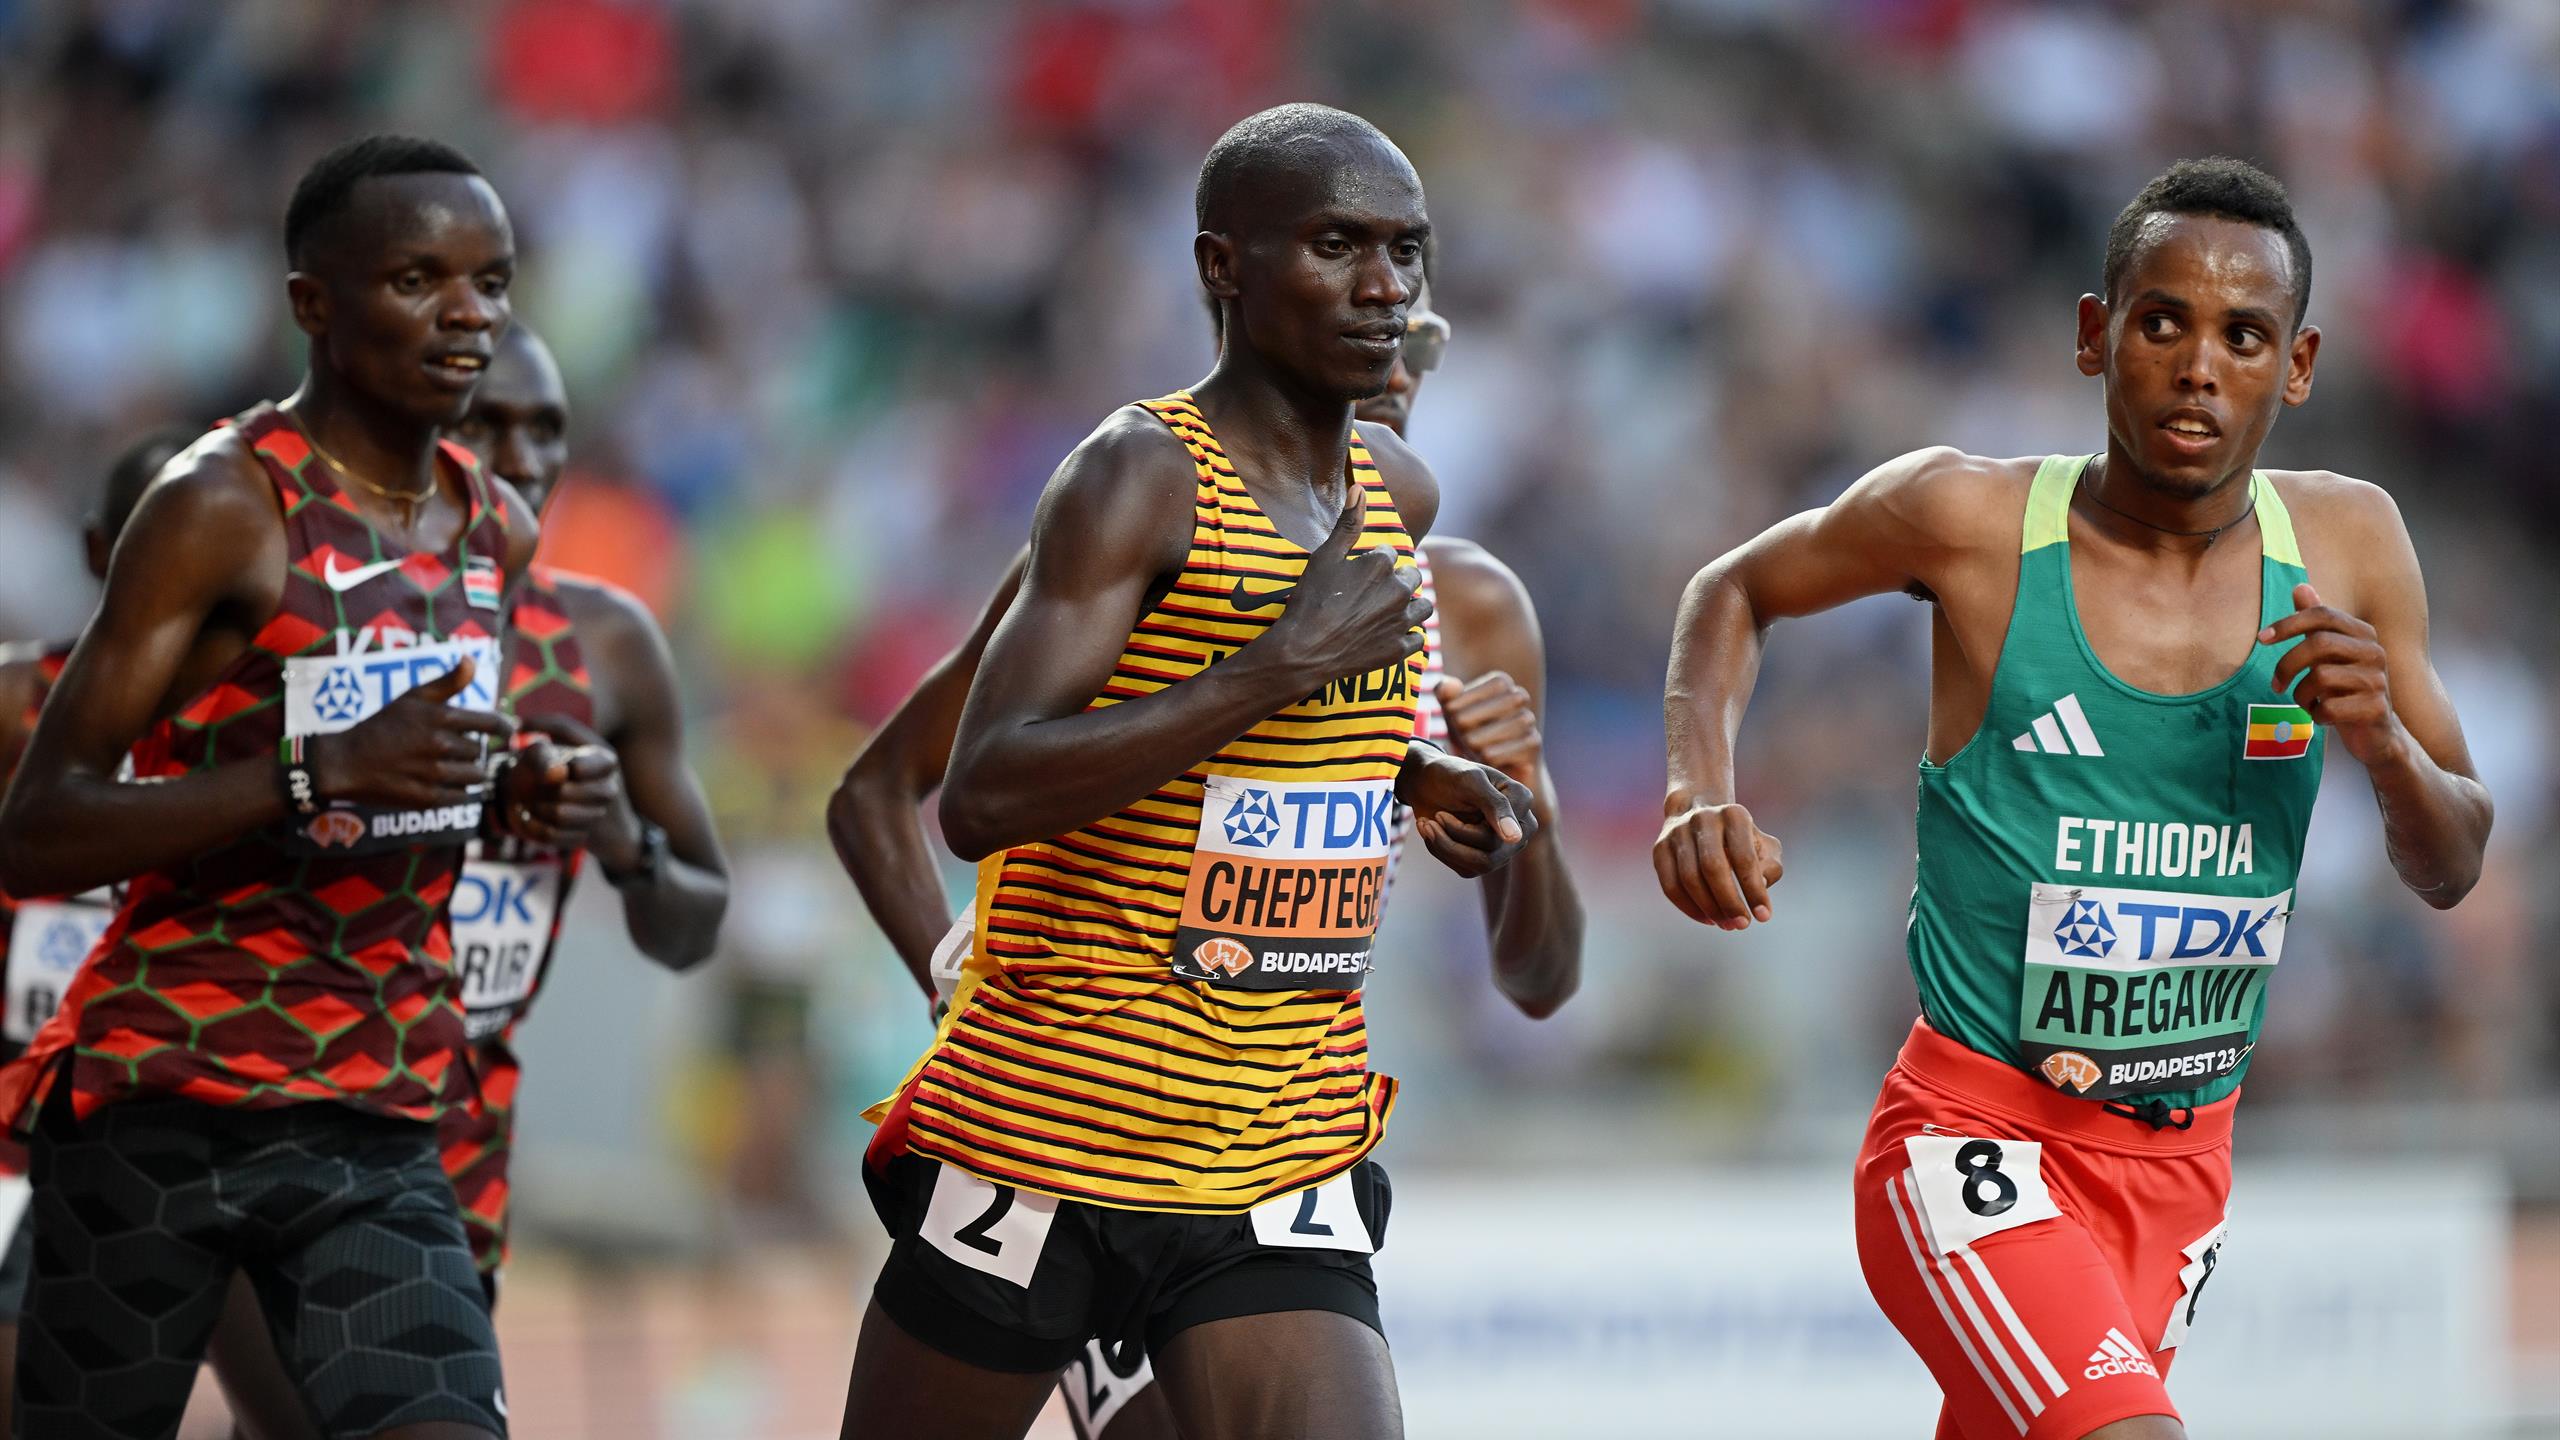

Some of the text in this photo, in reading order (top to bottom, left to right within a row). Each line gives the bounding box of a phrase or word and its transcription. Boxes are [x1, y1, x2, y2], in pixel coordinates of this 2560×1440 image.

[372, 803, 483, 837] BUDAPES
[1283, 790, 1393, 849] TDK
[2055, 816, 2253, 878] ETHIOPIA
[449, 874, 538, 924] DK
[1200, 860, 1384, 929] CHEPTEGE
[2117, 902, 2278, 961] TDK
[463, 942, 531, 993] RIR
[2035, 967, 2258, 1038] AREGAWI
[2109, 1047, 2236, 1085] BUDAPEST 23
[1955, 1139, 2018, 1217] 8
[952, 1178, 1016, 1257] 2
